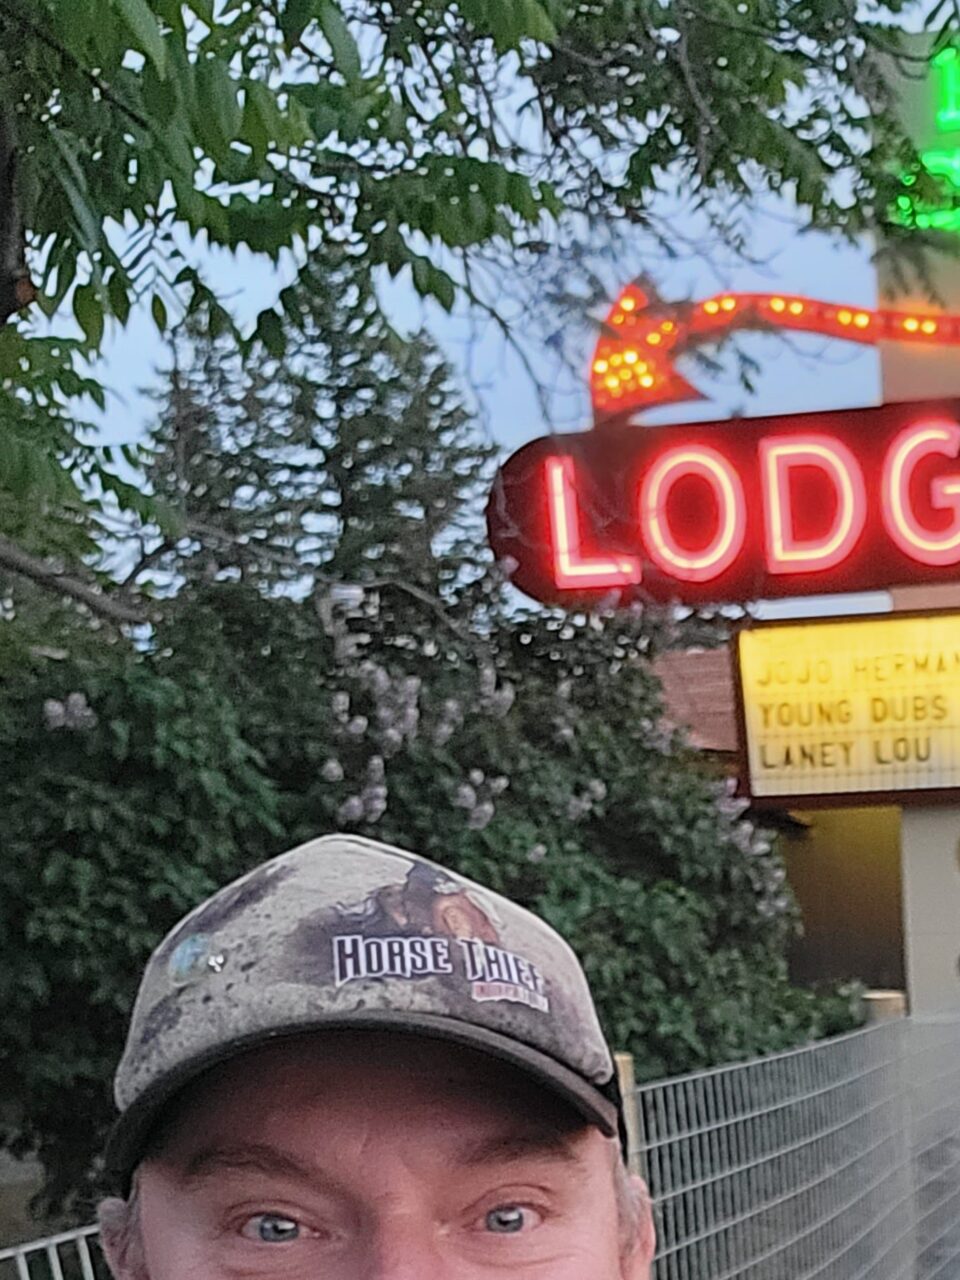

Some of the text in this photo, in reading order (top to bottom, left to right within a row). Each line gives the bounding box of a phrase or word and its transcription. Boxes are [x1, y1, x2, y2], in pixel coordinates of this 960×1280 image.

[757, 660, 832, 687] JOJO
[758, 699, 853, 728] YOUNG
[870, 695, 949, 723] DUBS
[759, 740, 855, 770] LANEY
[873, 736, 932, 764] LOU
[333, 936, 452, 986] HORSE
